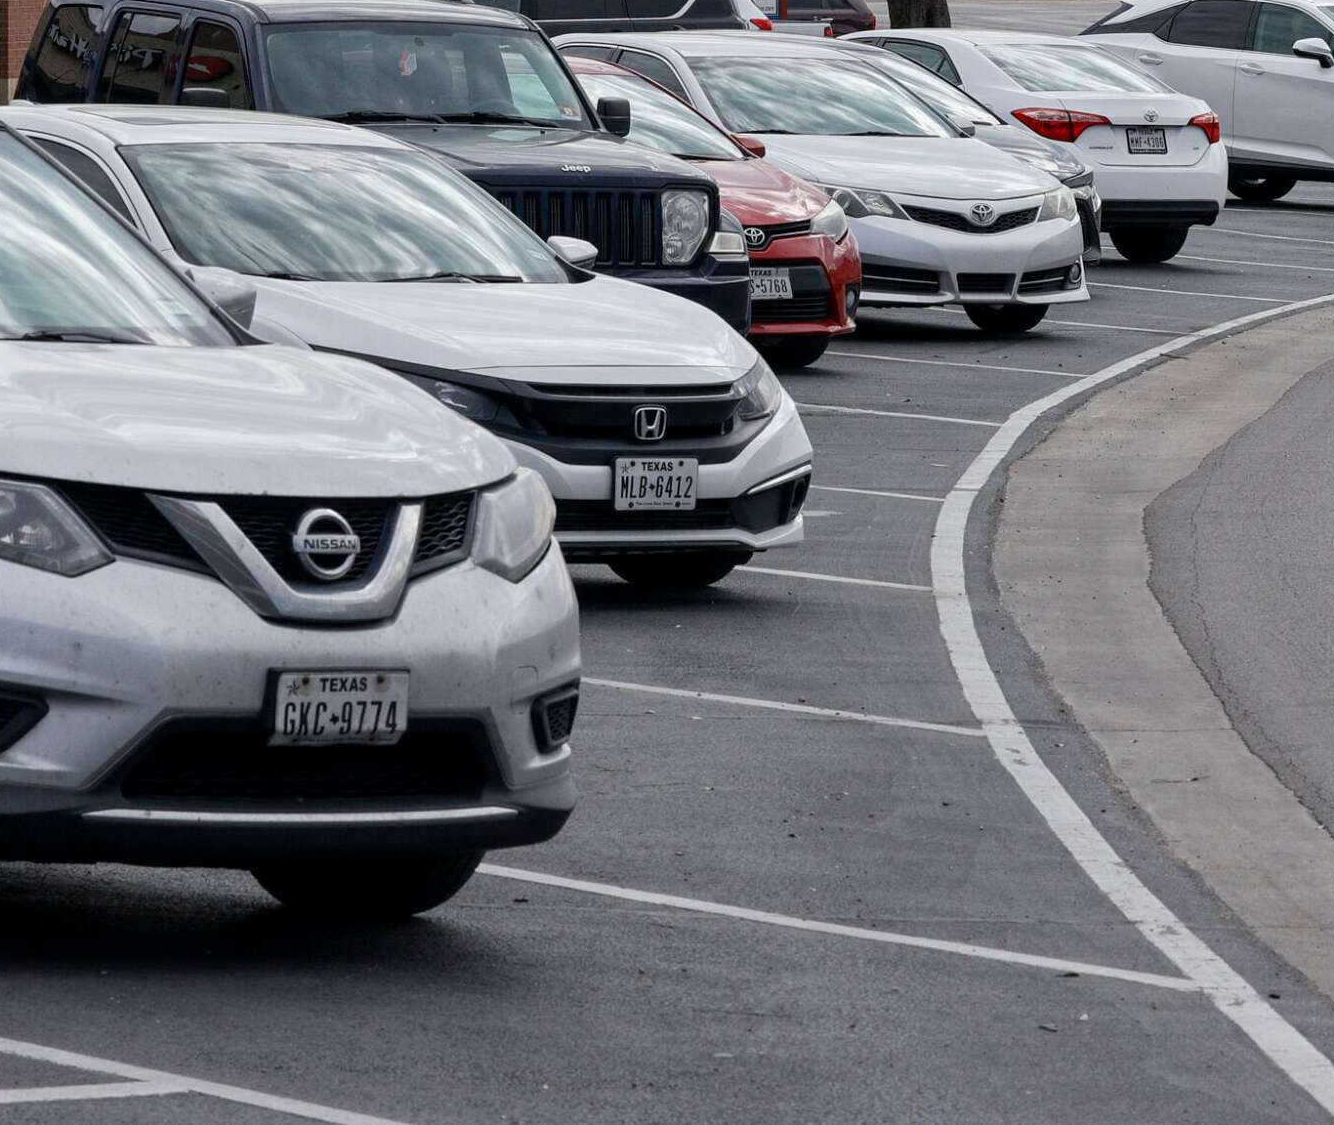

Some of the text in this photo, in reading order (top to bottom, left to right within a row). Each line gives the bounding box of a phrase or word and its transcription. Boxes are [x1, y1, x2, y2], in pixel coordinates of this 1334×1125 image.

[561, 164, 591, 173] Jeep
[641, 461, 674, 472] TEXAS
[303, 538, 358, 552] NISSAN
[319, 677, 368, 693] TEXAS
